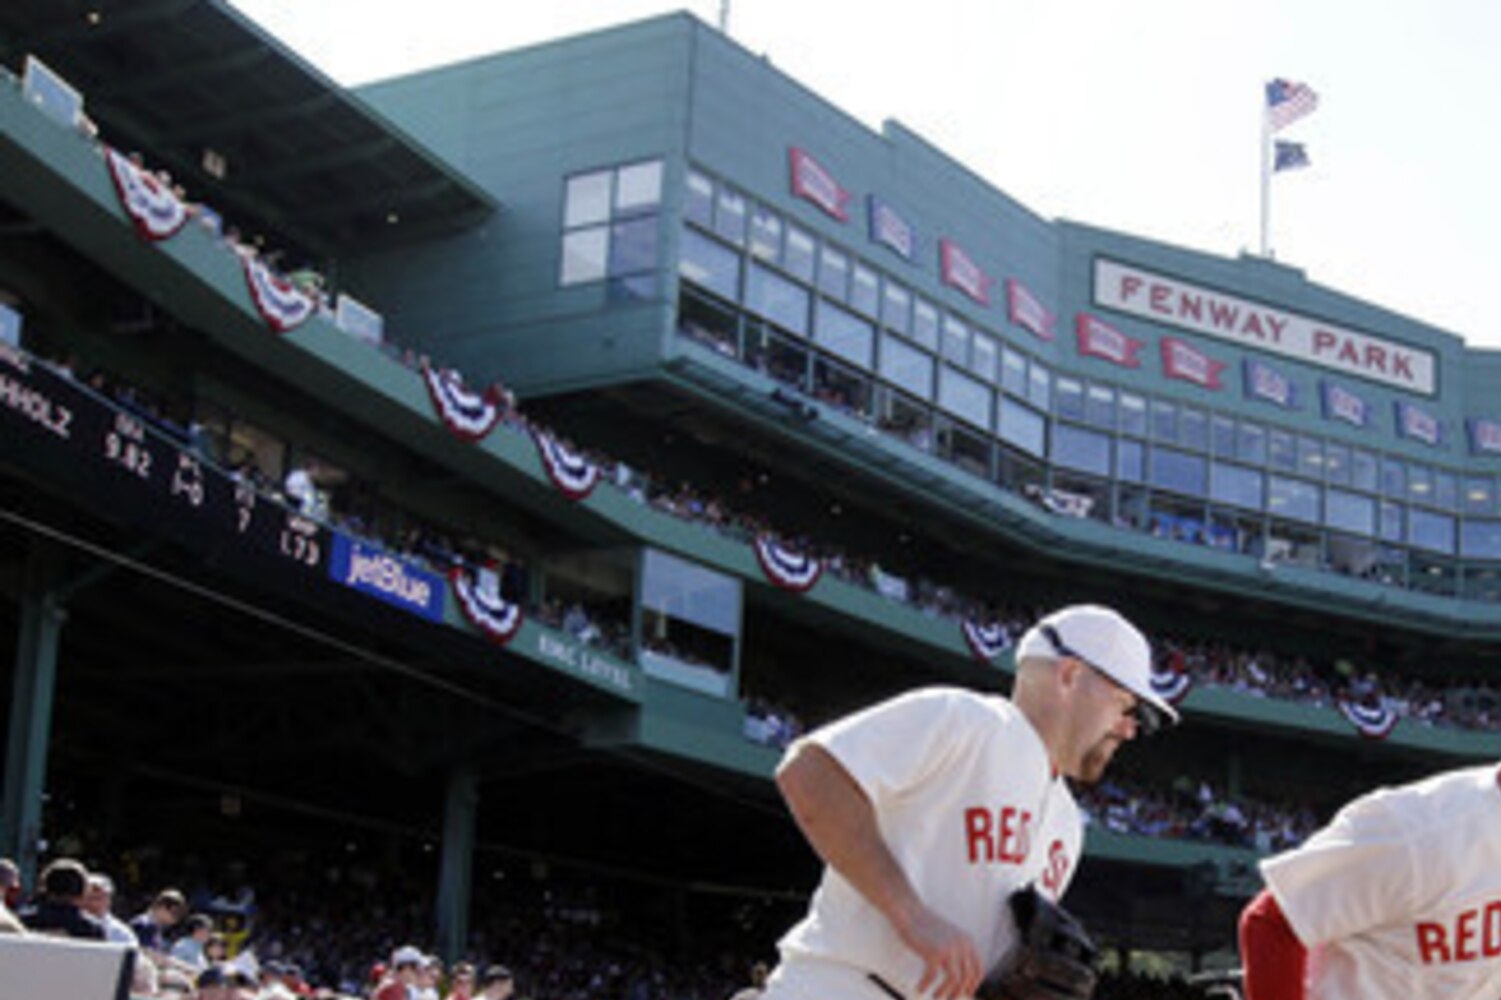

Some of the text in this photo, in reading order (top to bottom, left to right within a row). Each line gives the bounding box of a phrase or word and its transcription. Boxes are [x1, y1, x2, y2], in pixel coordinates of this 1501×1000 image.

[1120, 274, 1416, 381] FENWAY PARK
[346, 542, 430, 608] jetBlue
[965, 806, 1031, 866] RED
